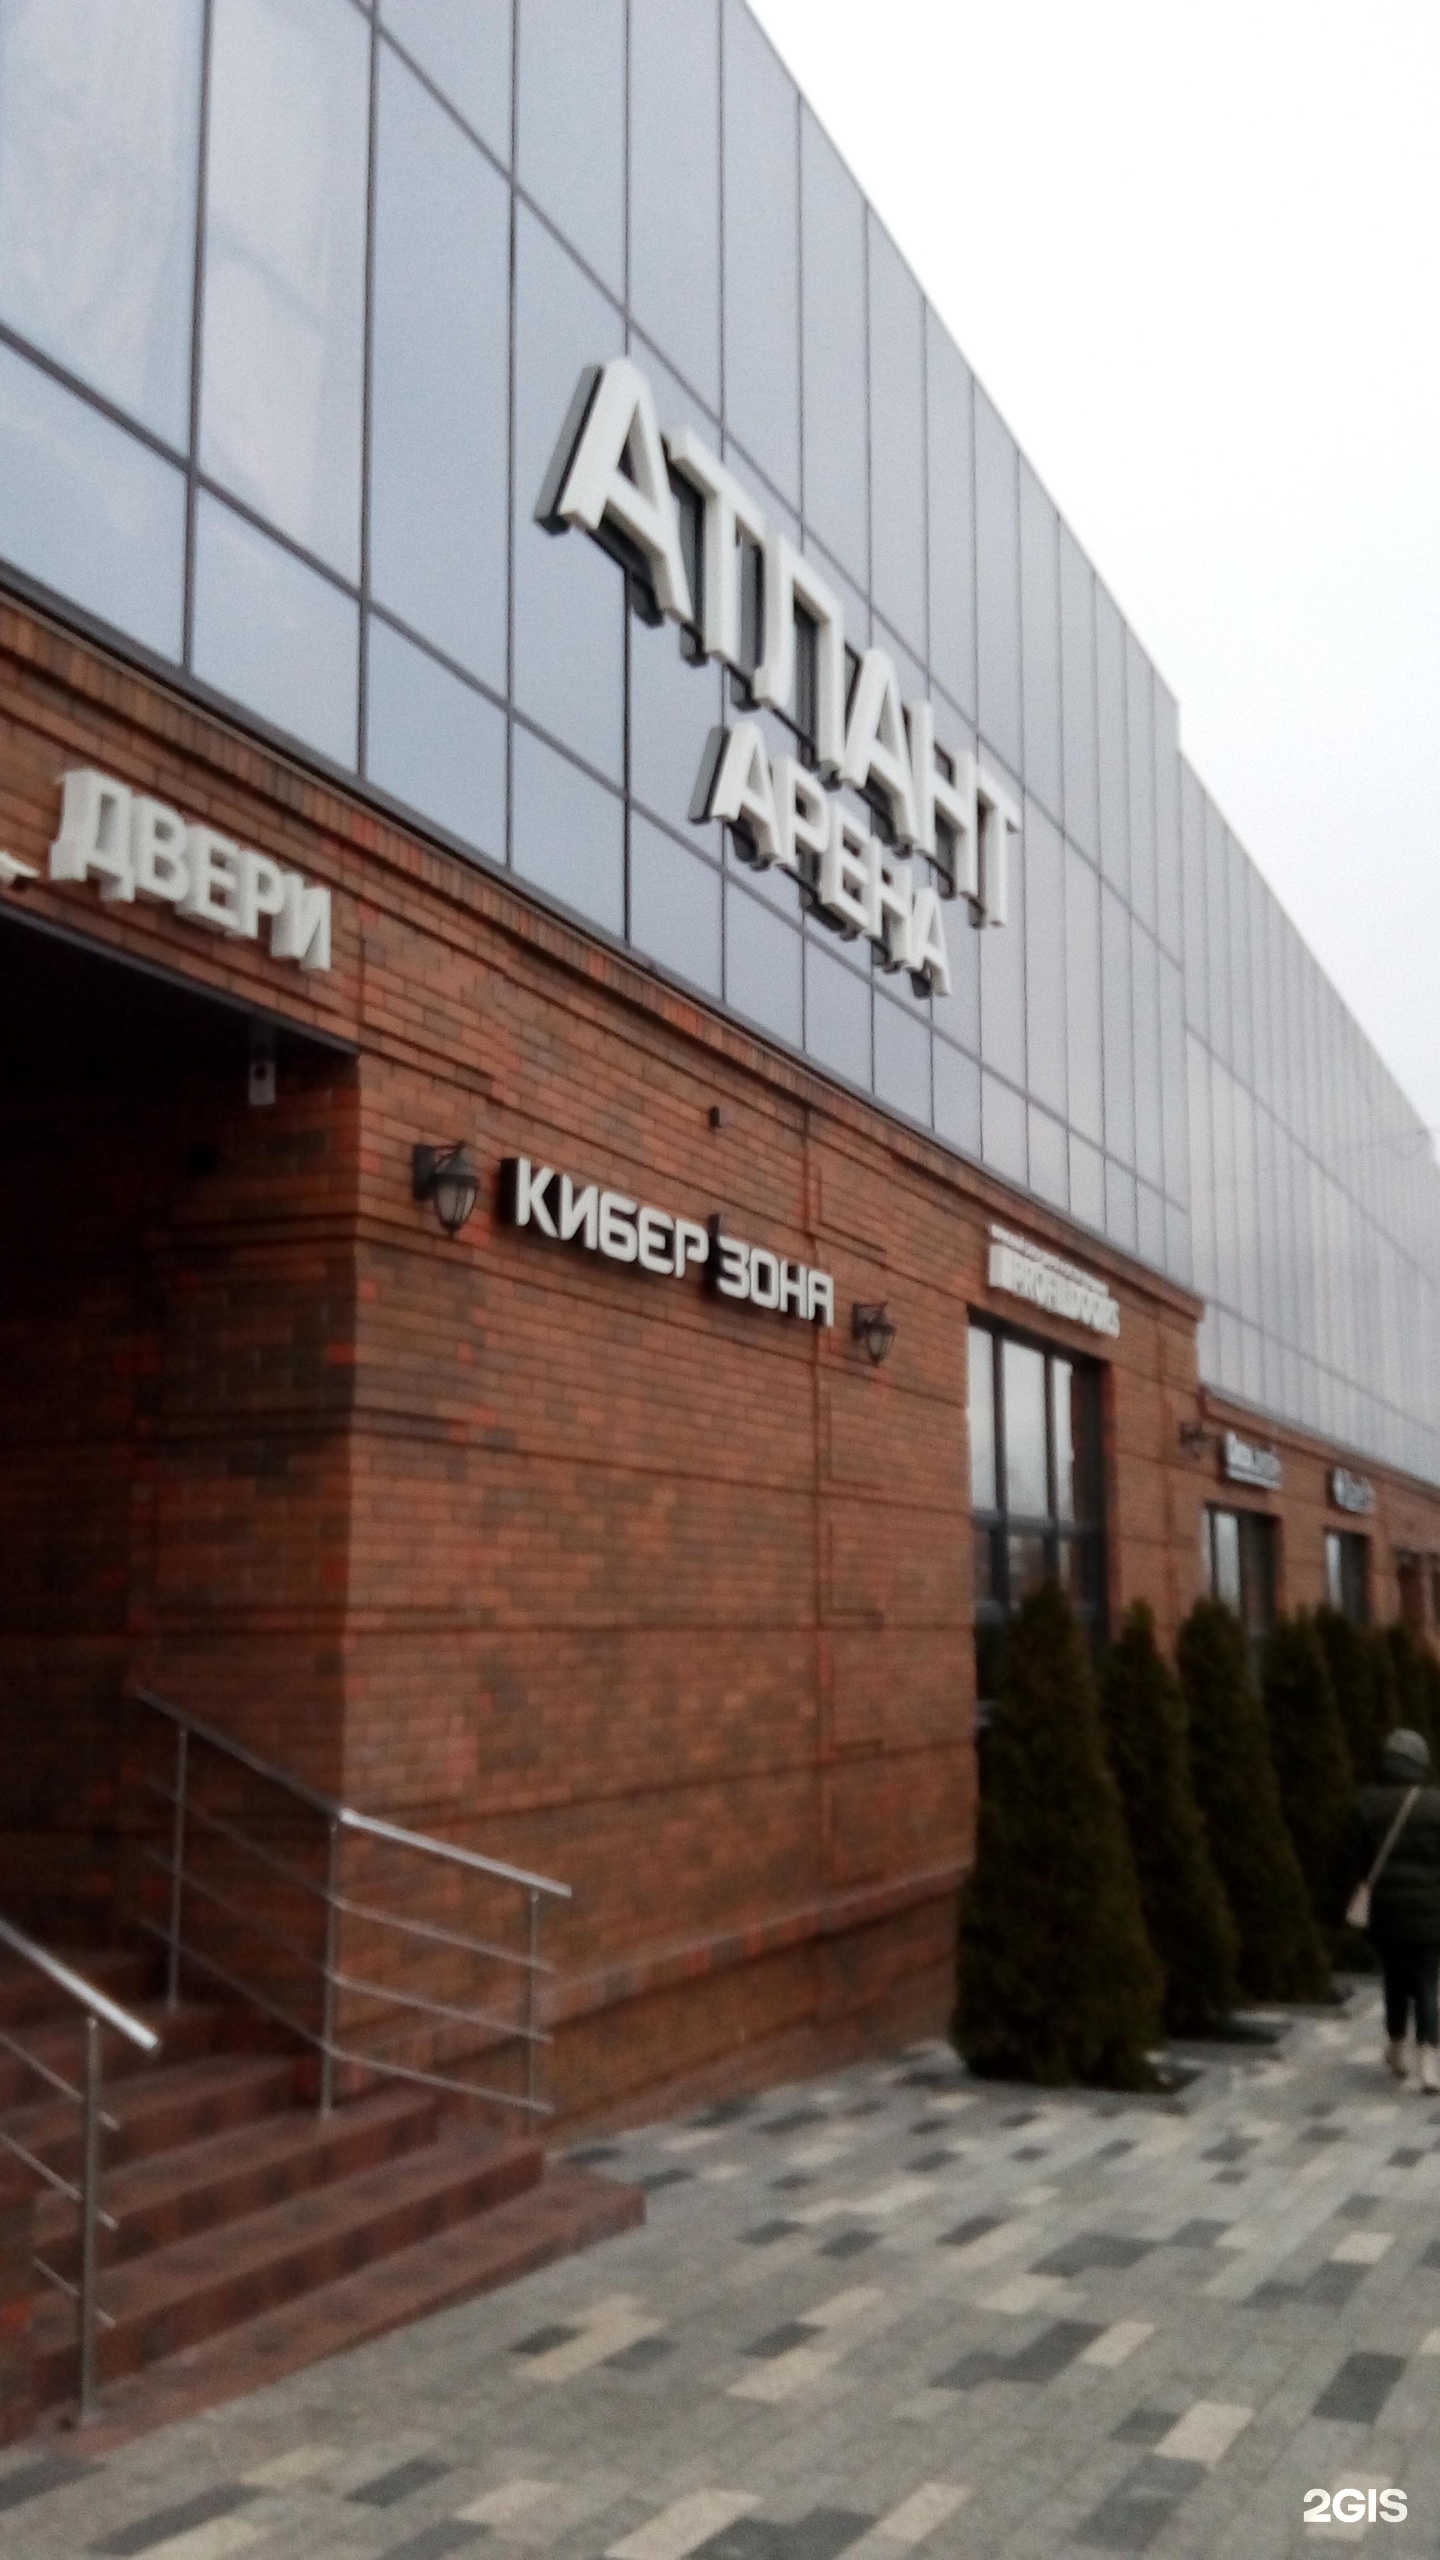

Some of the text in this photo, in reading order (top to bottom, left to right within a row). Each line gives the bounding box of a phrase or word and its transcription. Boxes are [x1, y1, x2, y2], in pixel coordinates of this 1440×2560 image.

[537, 359, 1020, 929] АТЛАНТ
[50, 768, 332, 971] ДВЕРИ
[691, 721, 952, 997] АРЕНА
[514, 1155, 835, 1329] КИБЕР ЗОНА
